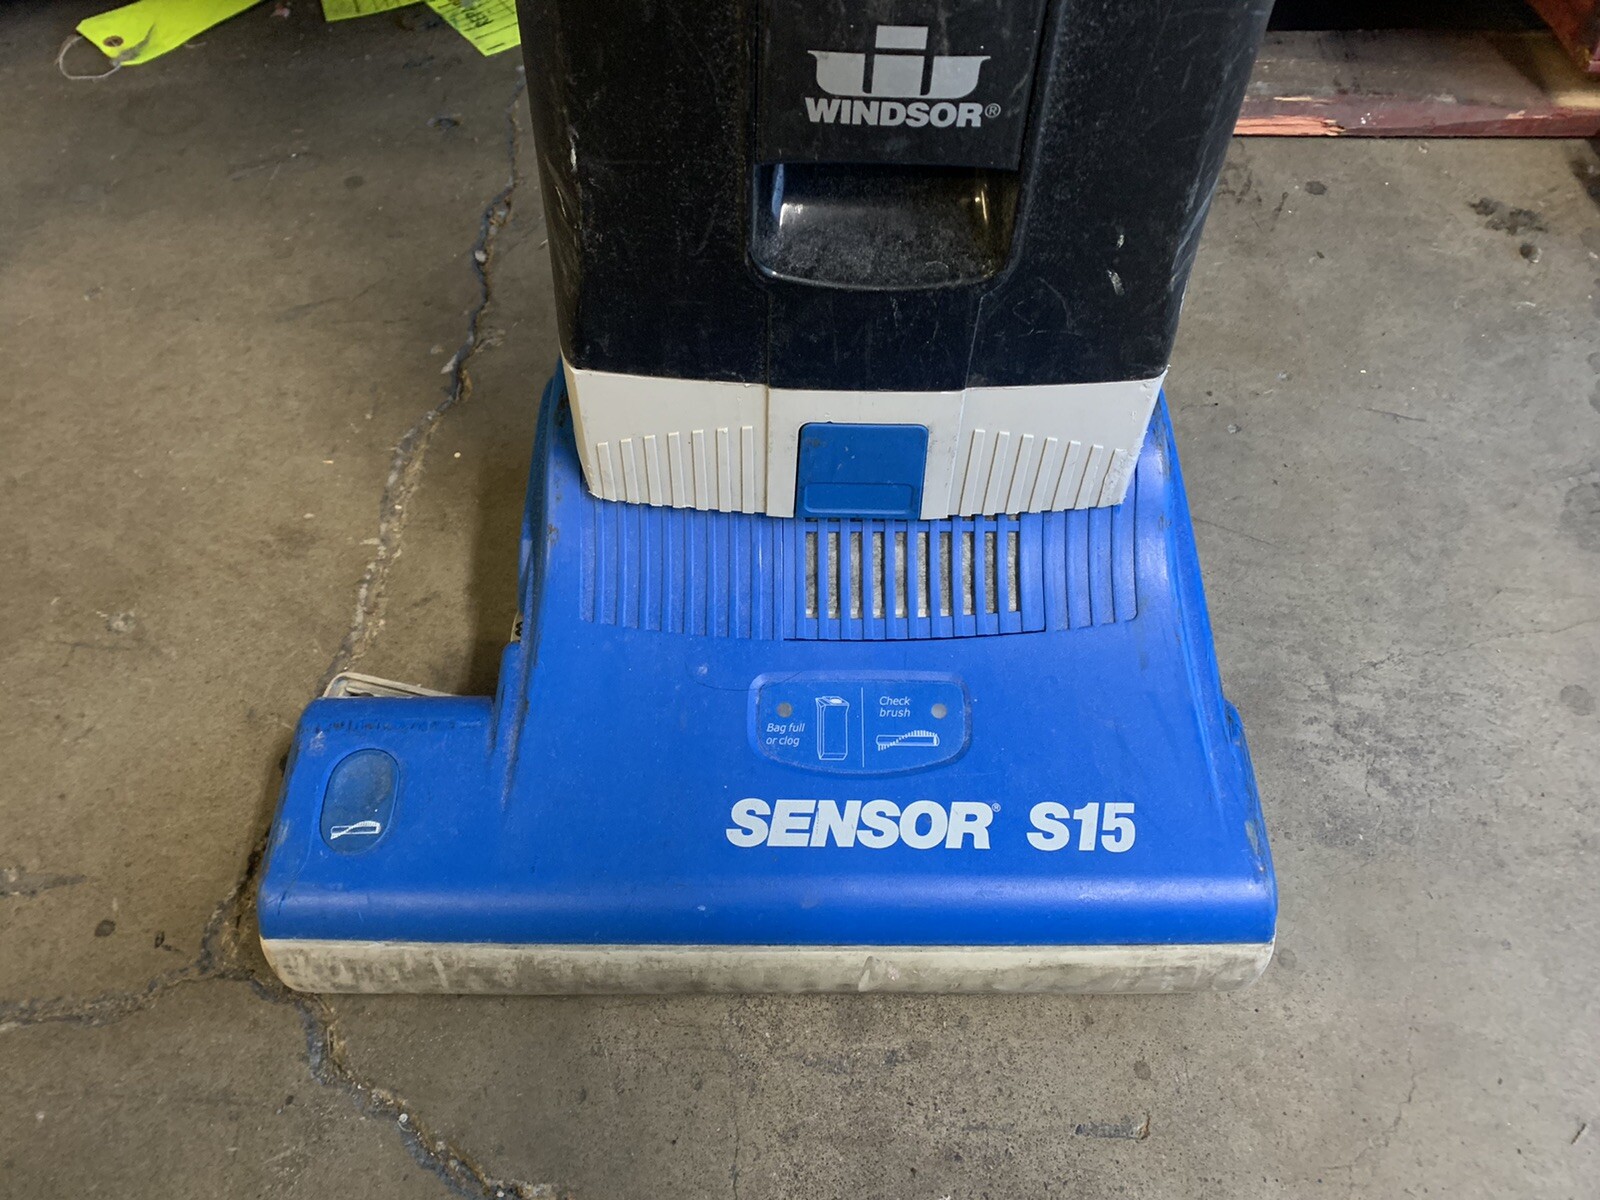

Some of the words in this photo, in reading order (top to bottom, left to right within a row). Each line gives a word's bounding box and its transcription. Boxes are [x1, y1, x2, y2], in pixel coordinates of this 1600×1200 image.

[879, 696, 911, 706] Check
[879, 707, 911, 718] brush
[766, 723, 786, 734] Bag
[788, 722, 804, 733] full
[766, 737, 778, 745] or
[779, 736, 799, 747] clog
[1026, 801, 1137, 853] S15
